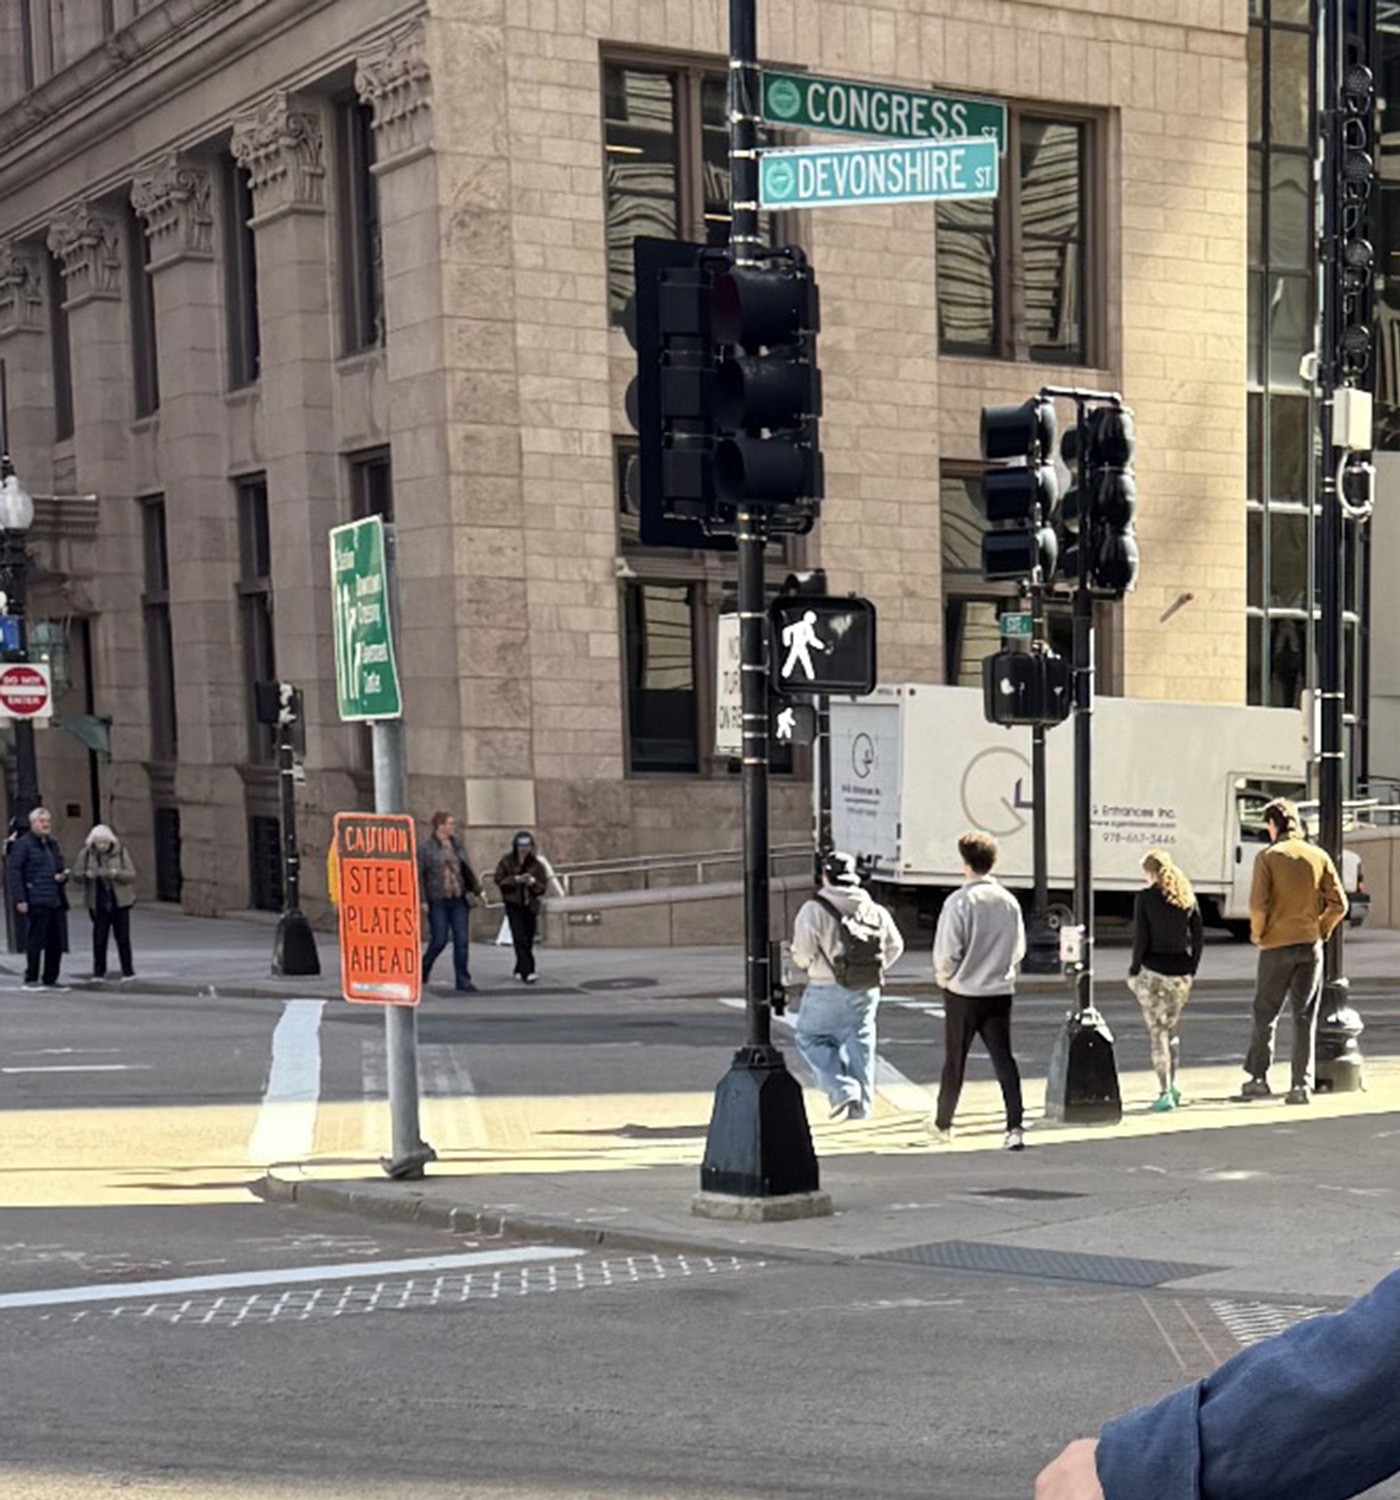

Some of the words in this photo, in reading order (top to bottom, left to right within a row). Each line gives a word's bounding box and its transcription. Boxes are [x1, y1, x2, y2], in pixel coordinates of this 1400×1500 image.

[806, 82, 968, 140] CONGRESS
[798, 150, 966, 198] DEVONSHIRE
[975, 166, 992, 189] ST
[344, 826, 409, 854] CAUTION
[350, 866, 408, 896] STEEL
[348, 906, 414, 936] PLATES
[351, 945, 415, 975] AHEAD
